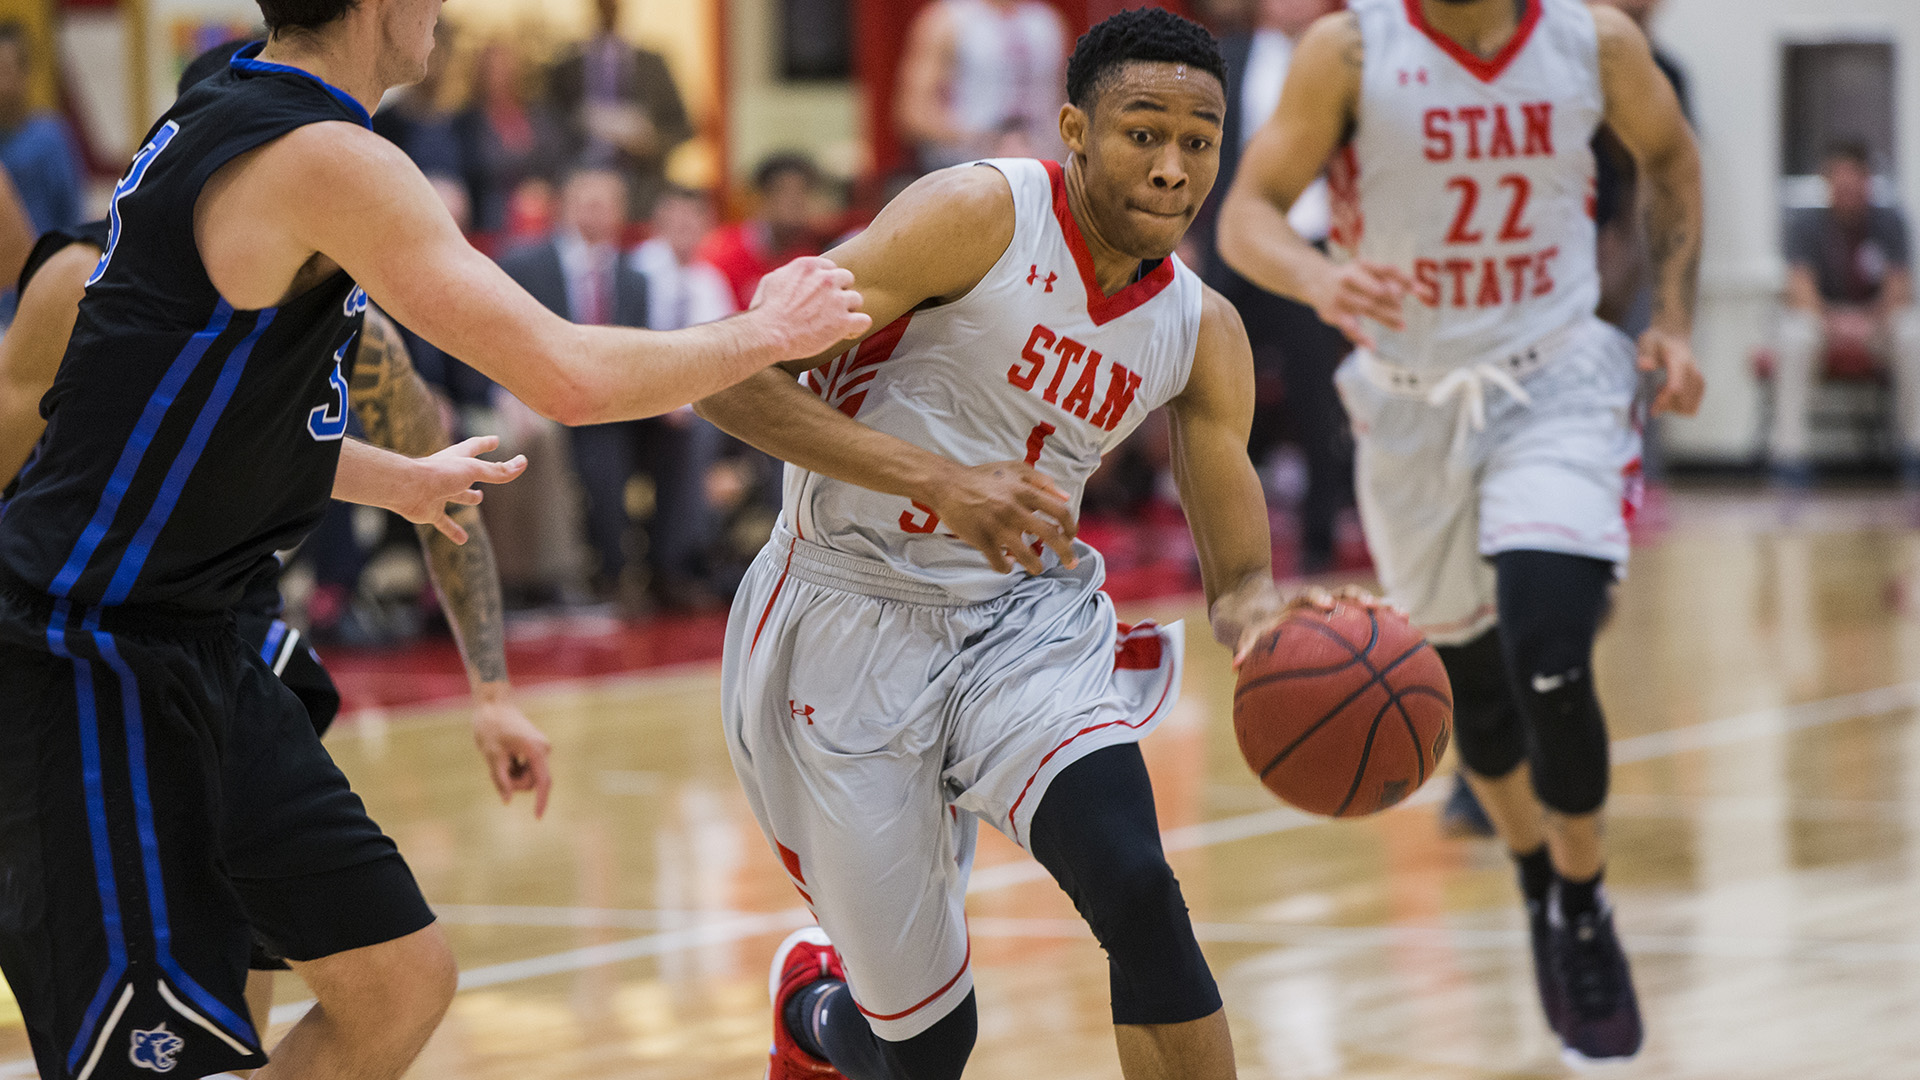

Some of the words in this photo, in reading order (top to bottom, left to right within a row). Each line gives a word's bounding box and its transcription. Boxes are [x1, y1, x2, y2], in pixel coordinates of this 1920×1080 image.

[1423, 103, 1554, 162] STAN
[1444, 172, 1534, 245] 22
[1413, 246, 1559, 308] STATE
[1007, 323, 1143, 432] STAN
